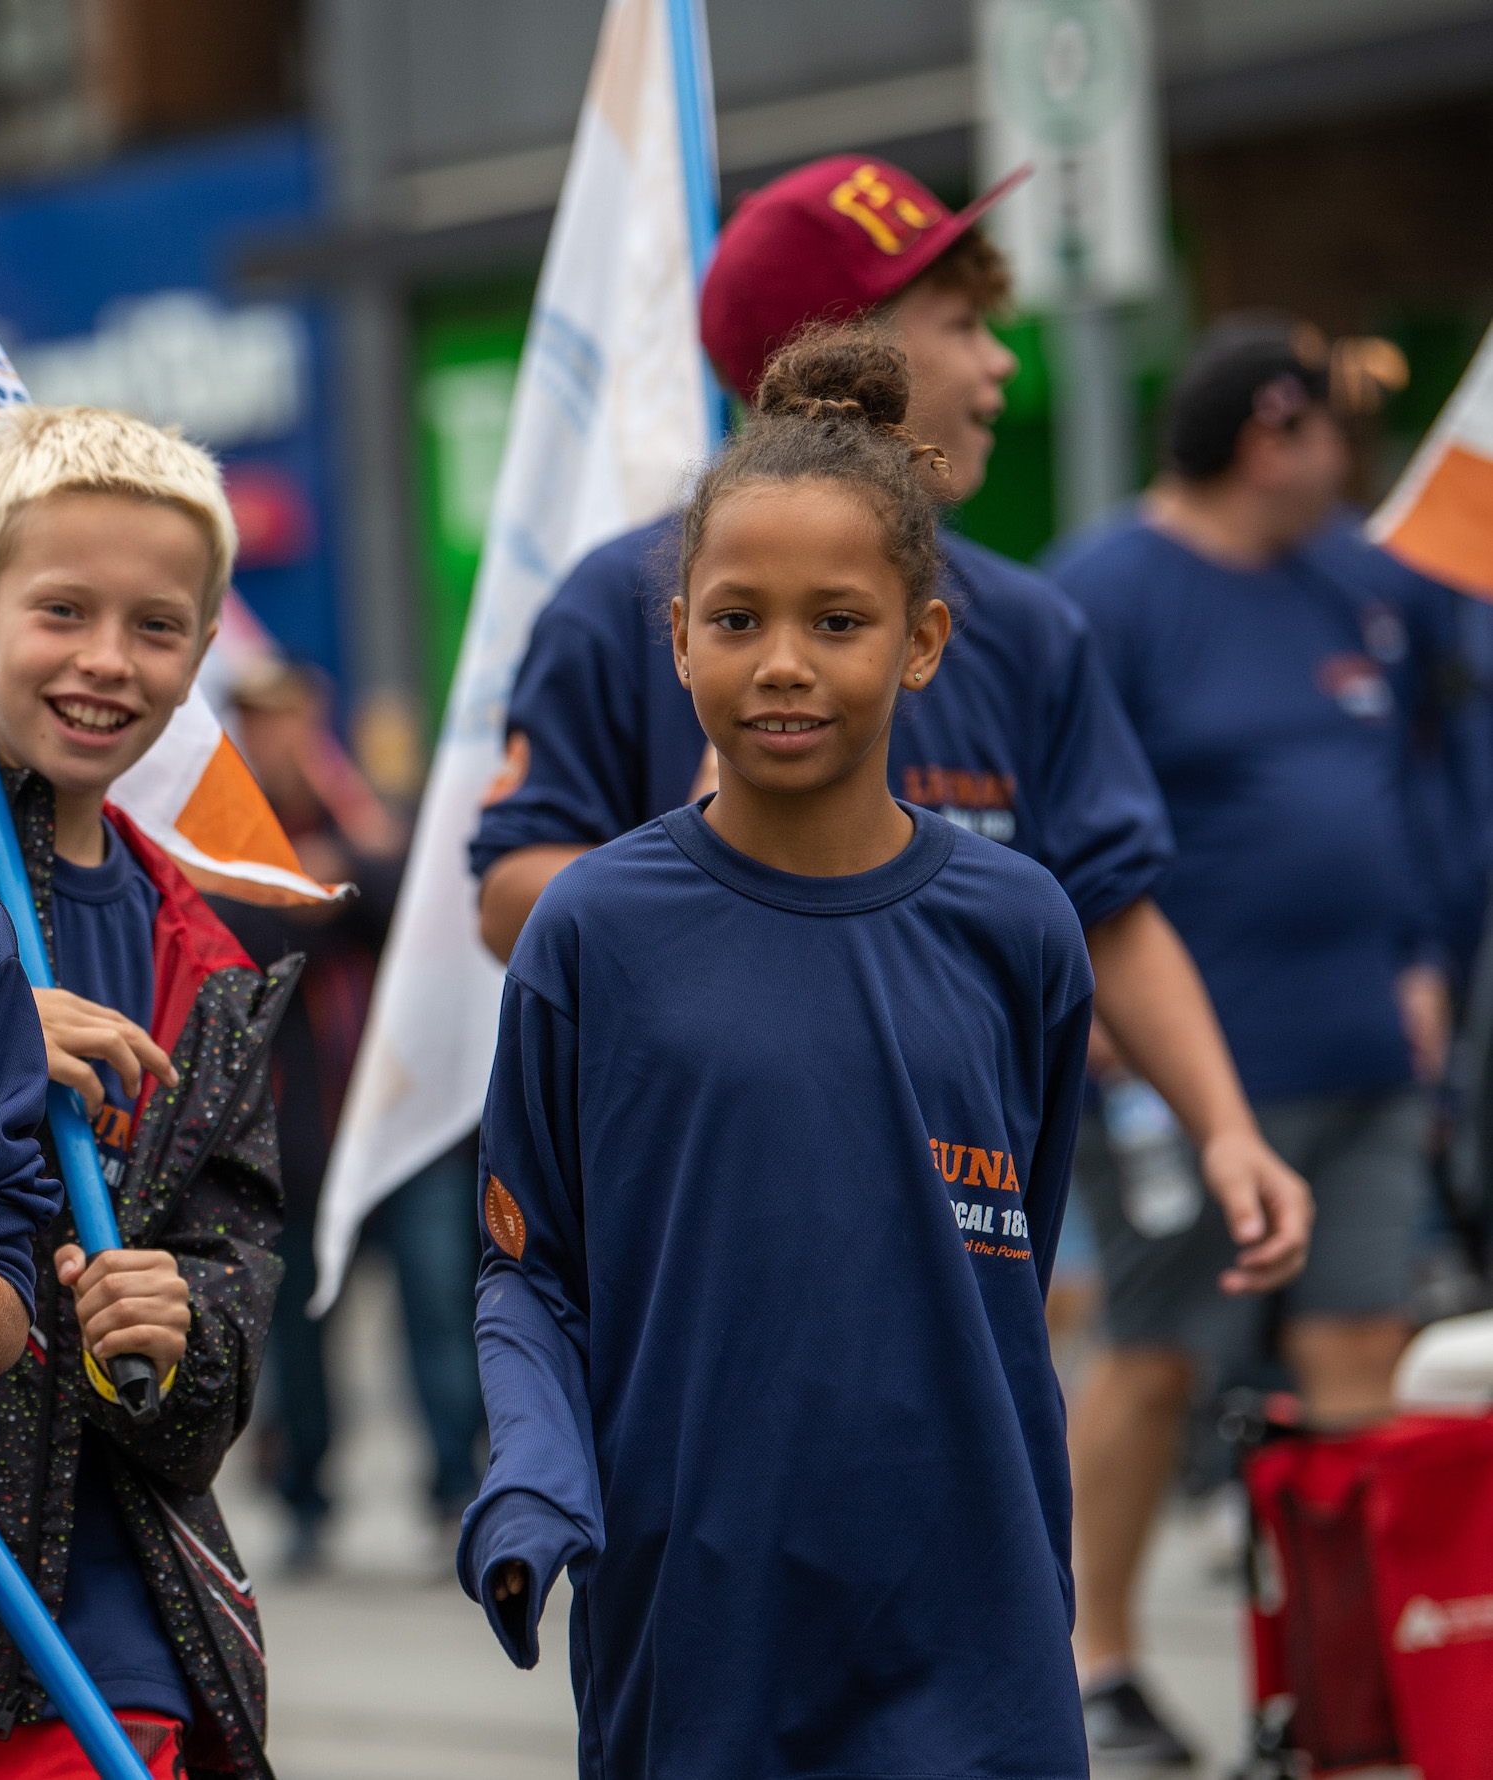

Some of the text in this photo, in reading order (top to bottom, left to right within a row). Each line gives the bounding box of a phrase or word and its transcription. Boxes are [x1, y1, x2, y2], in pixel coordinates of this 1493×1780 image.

[929, 1138, 1021, 1193] iUNA
[974, 1241, 995, 1255] the
[997, 1245, 1032, 1260] Power
